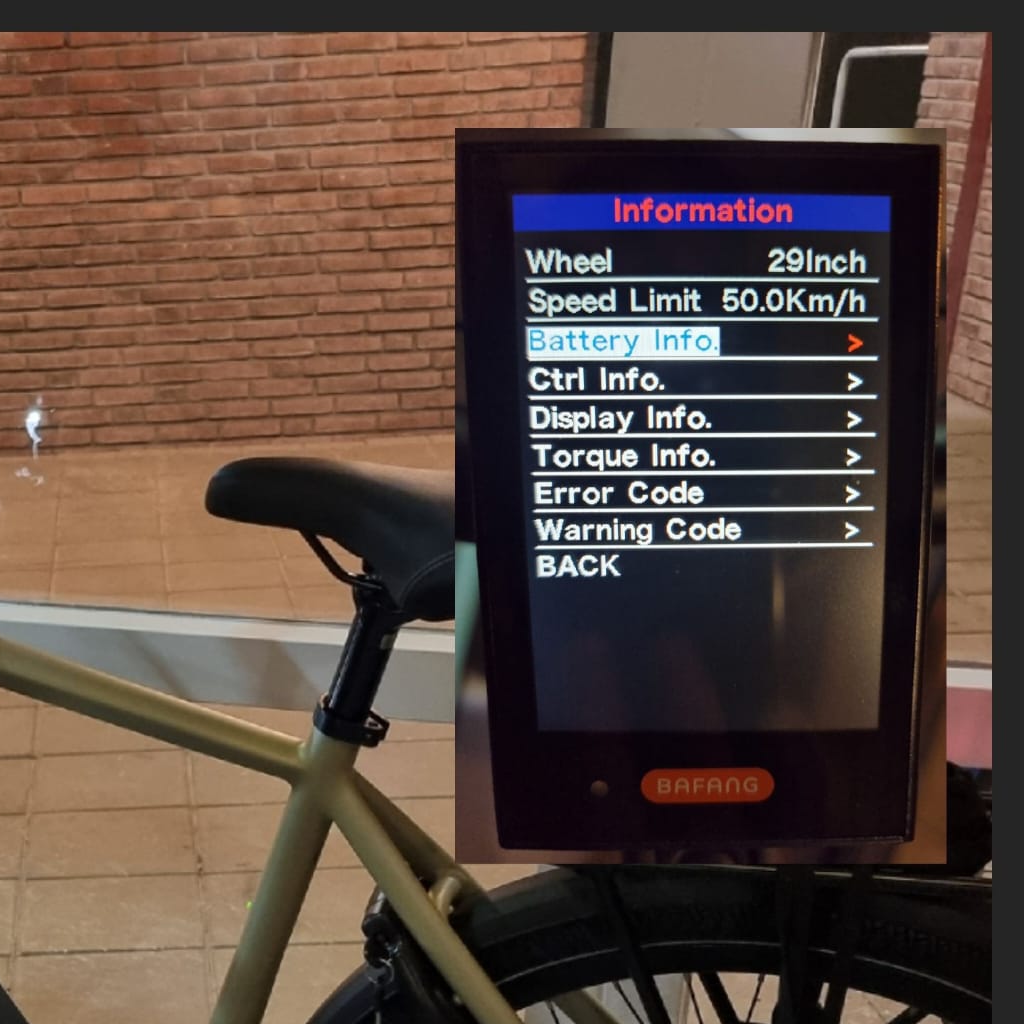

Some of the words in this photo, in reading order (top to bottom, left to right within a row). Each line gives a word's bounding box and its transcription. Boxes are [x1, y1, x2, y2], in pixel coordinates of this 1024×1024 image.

[614, 197, 793, 224] Information
[525, 248, 612, 274] Wheel
[768, 247, 865, 274] 29Inch
[528, 288, 616, 317] Speed
[631, 288, 702, 312] Limit
[722, 289, 866, 316] 50.0Km/h
[530, 329, 639, 357] Battery
[656, 329, 717, 351] Info.
[528, 367, 584, 391] Ctrl
[600, 367, 664, 391] Info.
[529, 406, 634, 432] Display
[648, 404, 711, 430] Info.
[531, 444, 638, 470] Torque
[652, 443, 715, 467] Info.
[534, 482, 614, 505] Error
[628, 481, 704, 504] Code
[534, 518, 653, 543] Warning
[666, 517, 741, 541] Code
[536, 554, 621, 577] BACK
[657, 776, 758, 795] BAFANG
